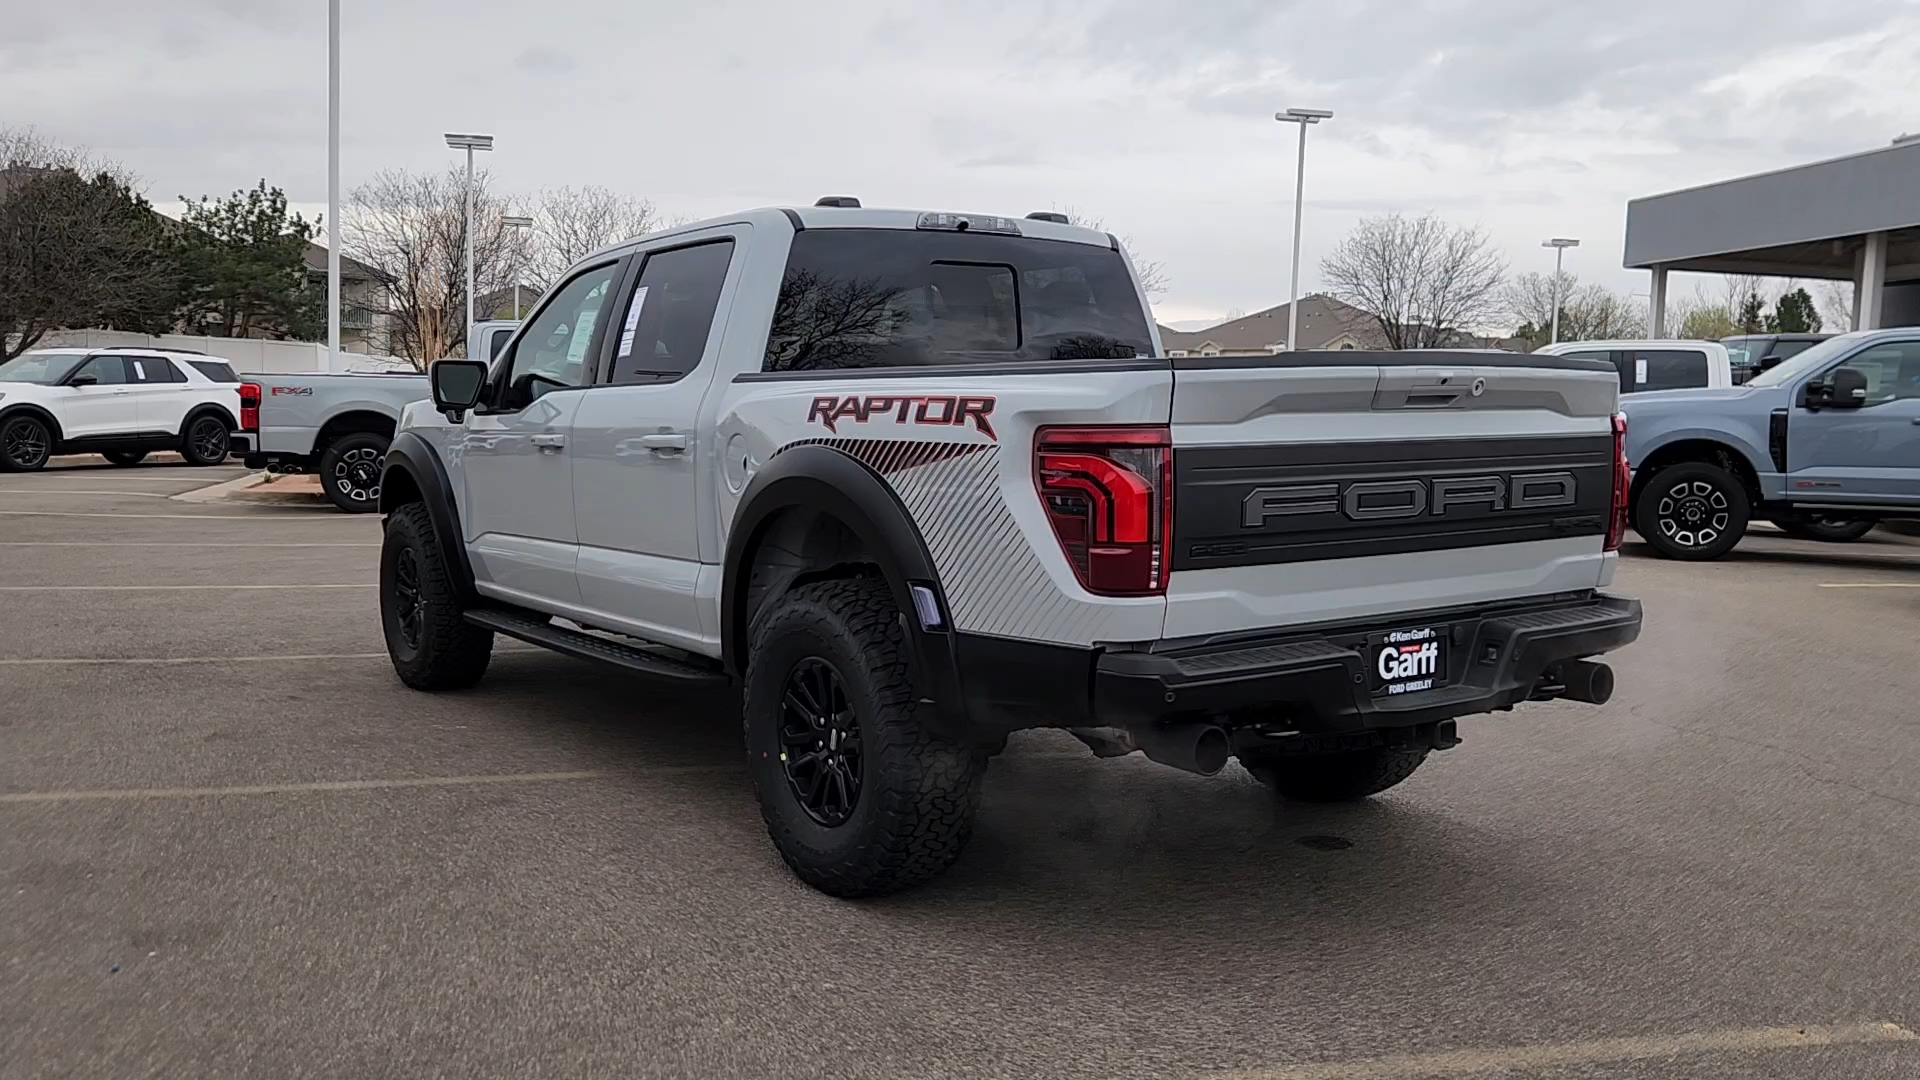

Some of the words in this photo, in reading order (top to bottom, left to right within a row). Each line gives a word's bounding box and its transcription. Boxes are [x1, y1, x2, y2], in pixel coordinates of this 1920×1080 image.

[271, 386, 313, 396] FX4
[806, 395, 998, 442] RAPTOR
[1240, 470, 1578, 528] FORD
[1397, 630, 1411, 641] Ken
[1411, 628, 1430, 640] Garff
[1378, 641, 1438, 680] Garff
[1388, 683, 1405, 695] FORD
[1406, 679, 1433, 692] GREELEY
